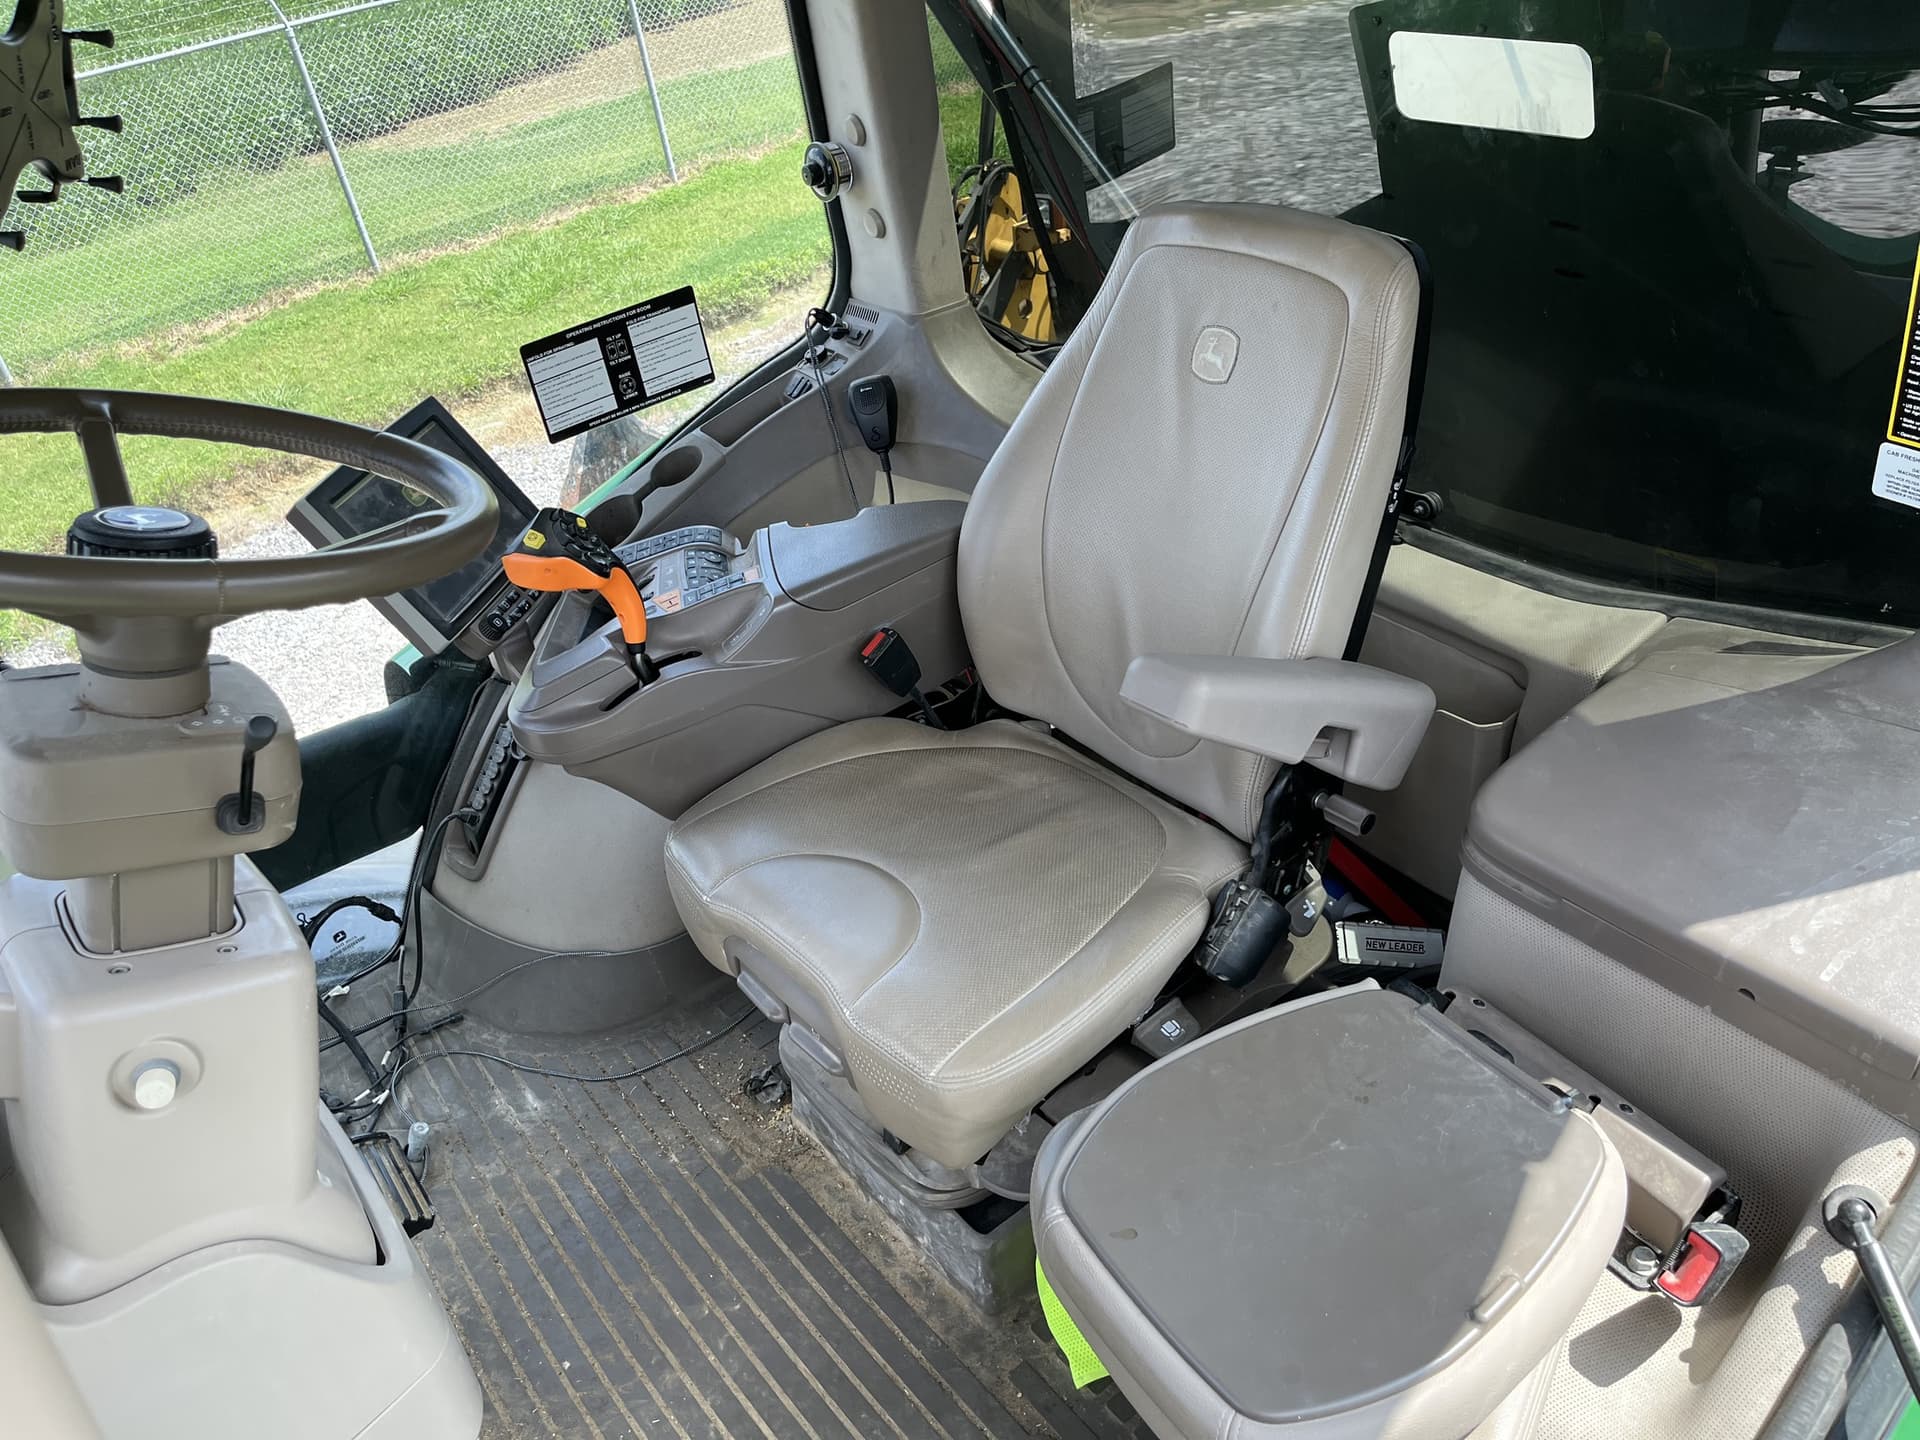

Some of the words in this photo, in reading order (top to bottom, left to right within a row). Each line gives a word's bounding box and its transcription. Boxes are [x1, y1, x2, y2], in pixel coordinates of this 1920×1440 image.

[645, 305, 670, 318] TRANSPORT
[565, 324, 593, 339] OPERATING
[592, 312, 626, 329] INSTRUCTIONS
[626, 308, 636, 316] FOR
[635, 303, 651, 313] BOOM
[617, 354, 631, 363] DOWN
[617, 370, 631, 379] RAISE
[622, 390, 638, 400] LOWER
[1887, 449, 1899, 457] CAB
[1366, 940, 1387, 949] NEW
[1388, 941, 1424, 952] LEADER
